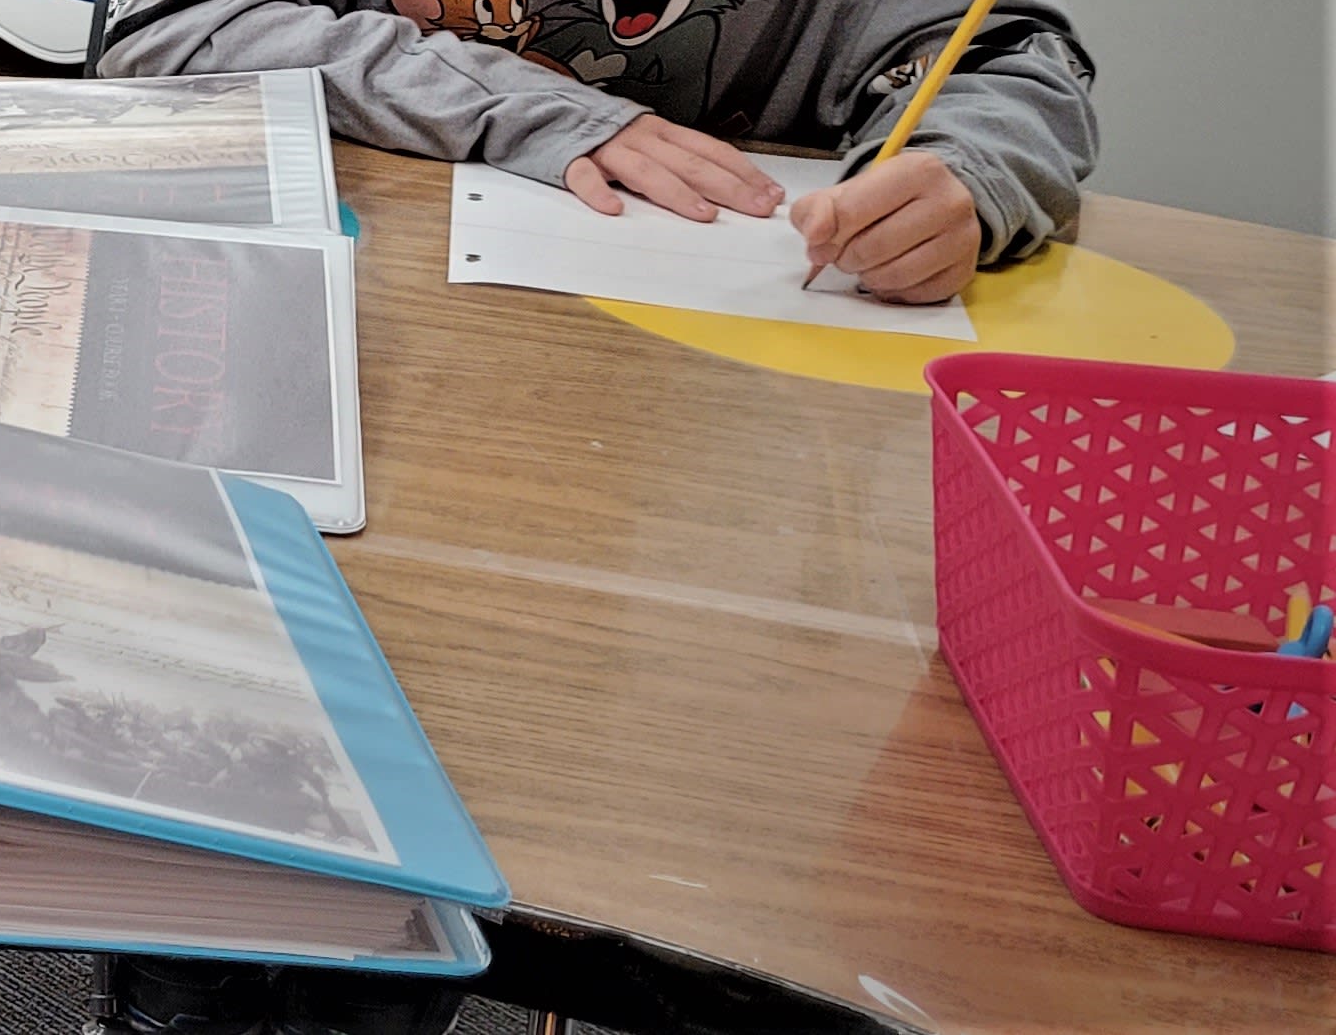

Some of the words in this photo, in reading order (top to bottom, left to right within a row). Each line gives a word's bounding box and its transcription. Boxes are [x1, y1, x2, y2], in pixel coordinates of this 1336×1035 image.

[0, 274, 72, 336] People
[103, 323, 124, 364] COURSE
[151, 254, 229, 444] HISTORY
